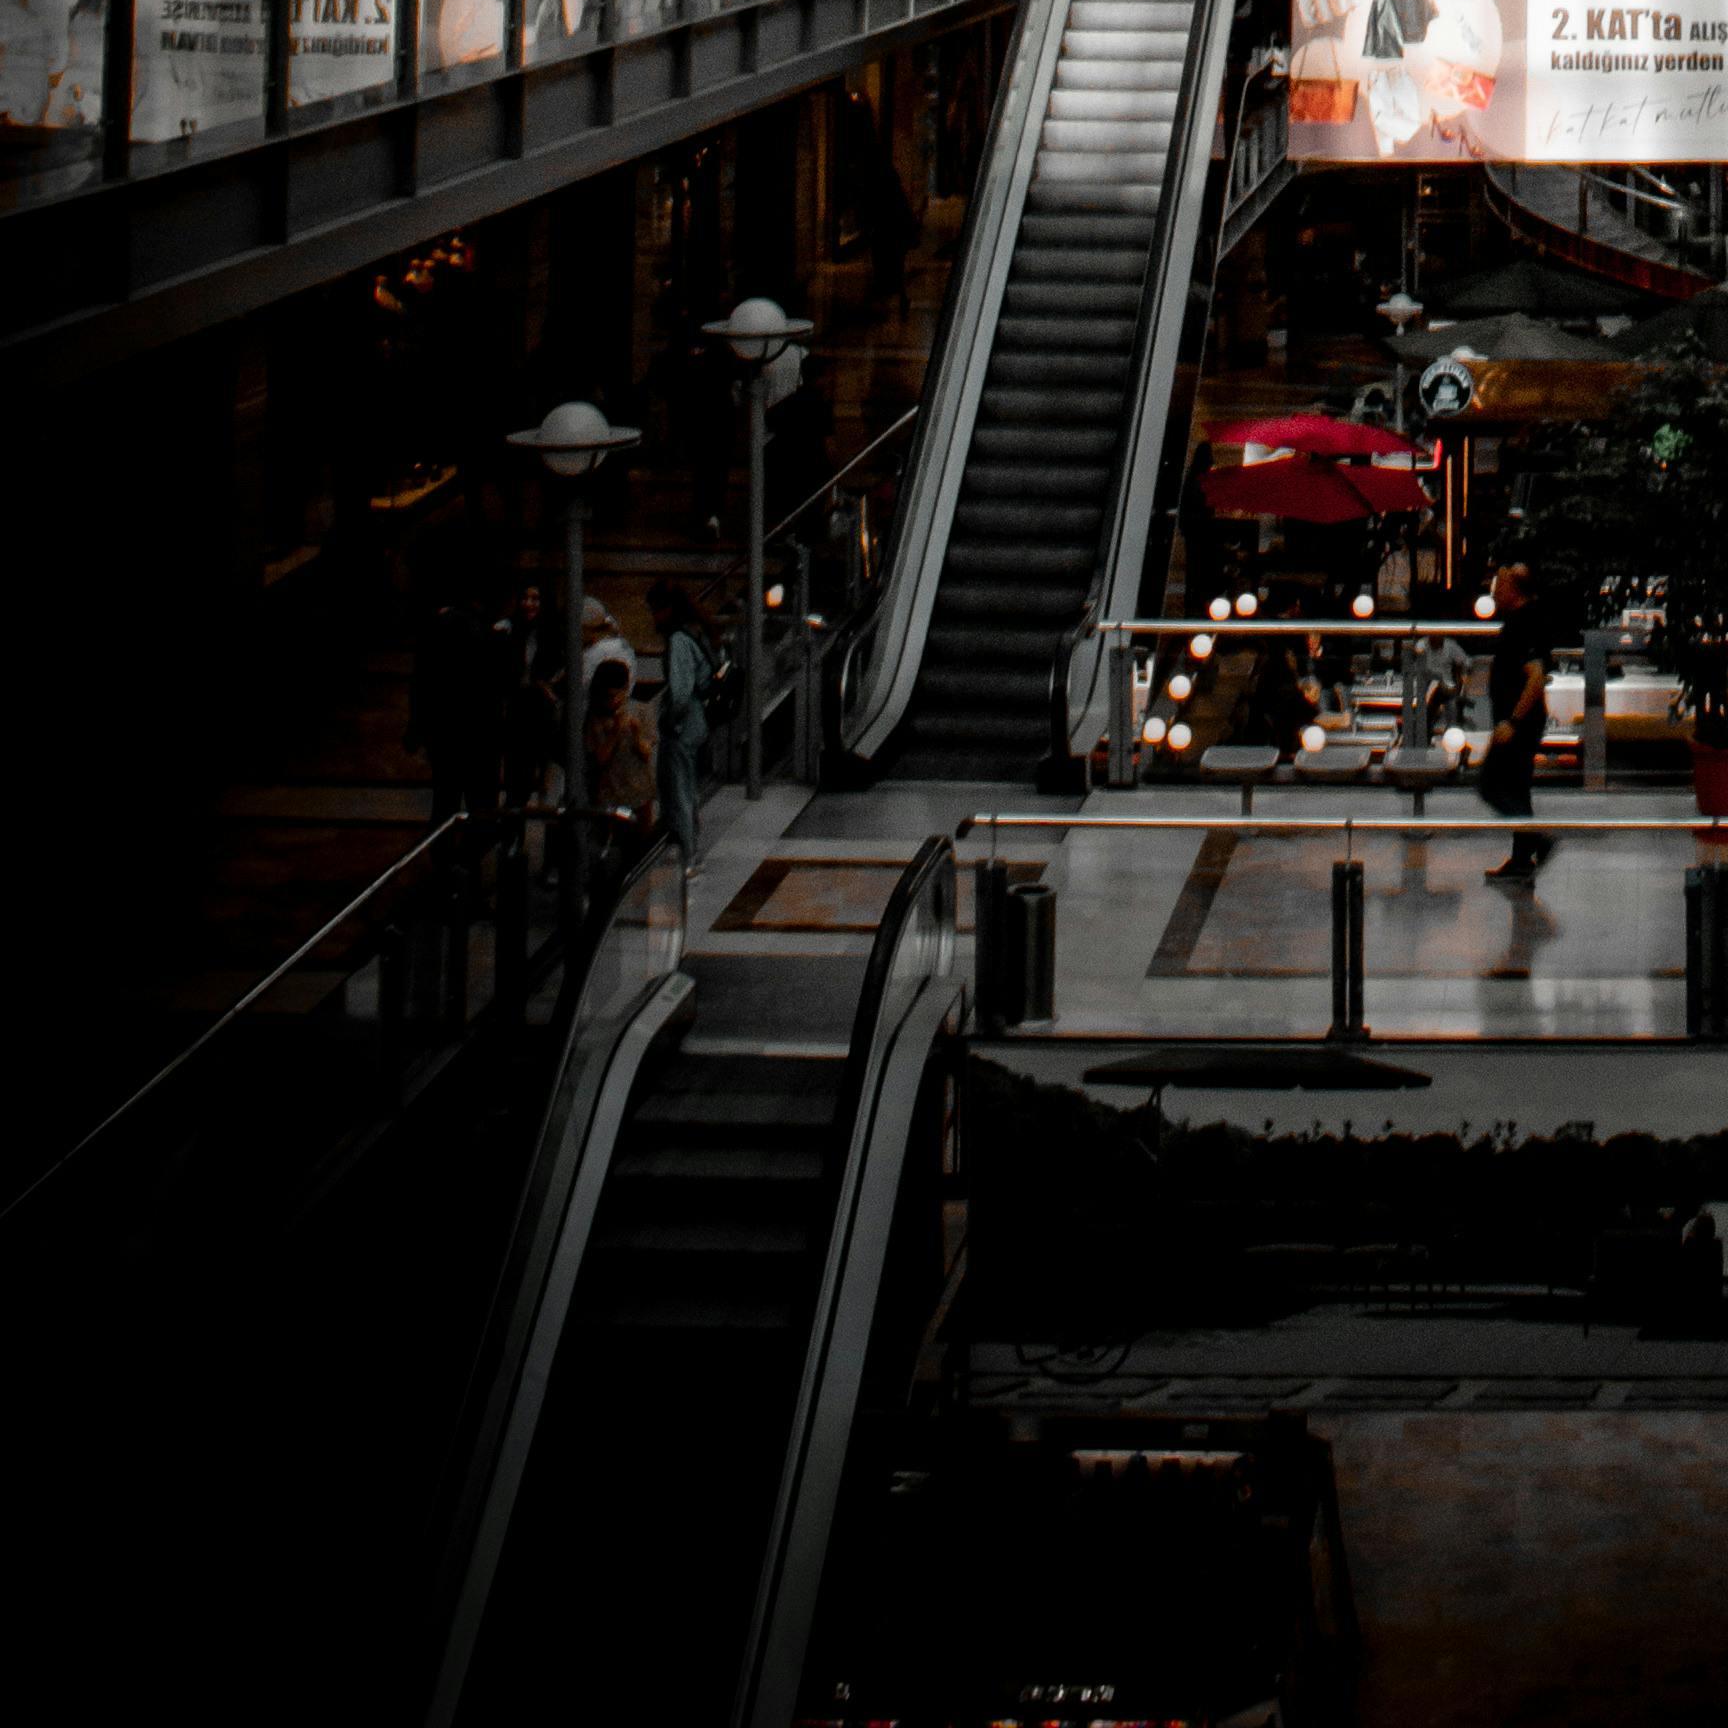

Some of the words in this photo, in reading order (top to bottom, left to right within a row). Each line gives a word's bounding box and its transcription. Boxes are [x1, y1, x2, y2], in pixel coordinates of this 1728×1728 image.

[1551, 7, 1577, 41] 2.
[1586, 7, 1683, 41] KAT'ta
[1551, 48, 1649, 73] kaldığınız
[1653, 50, 1724, 73] yerden
